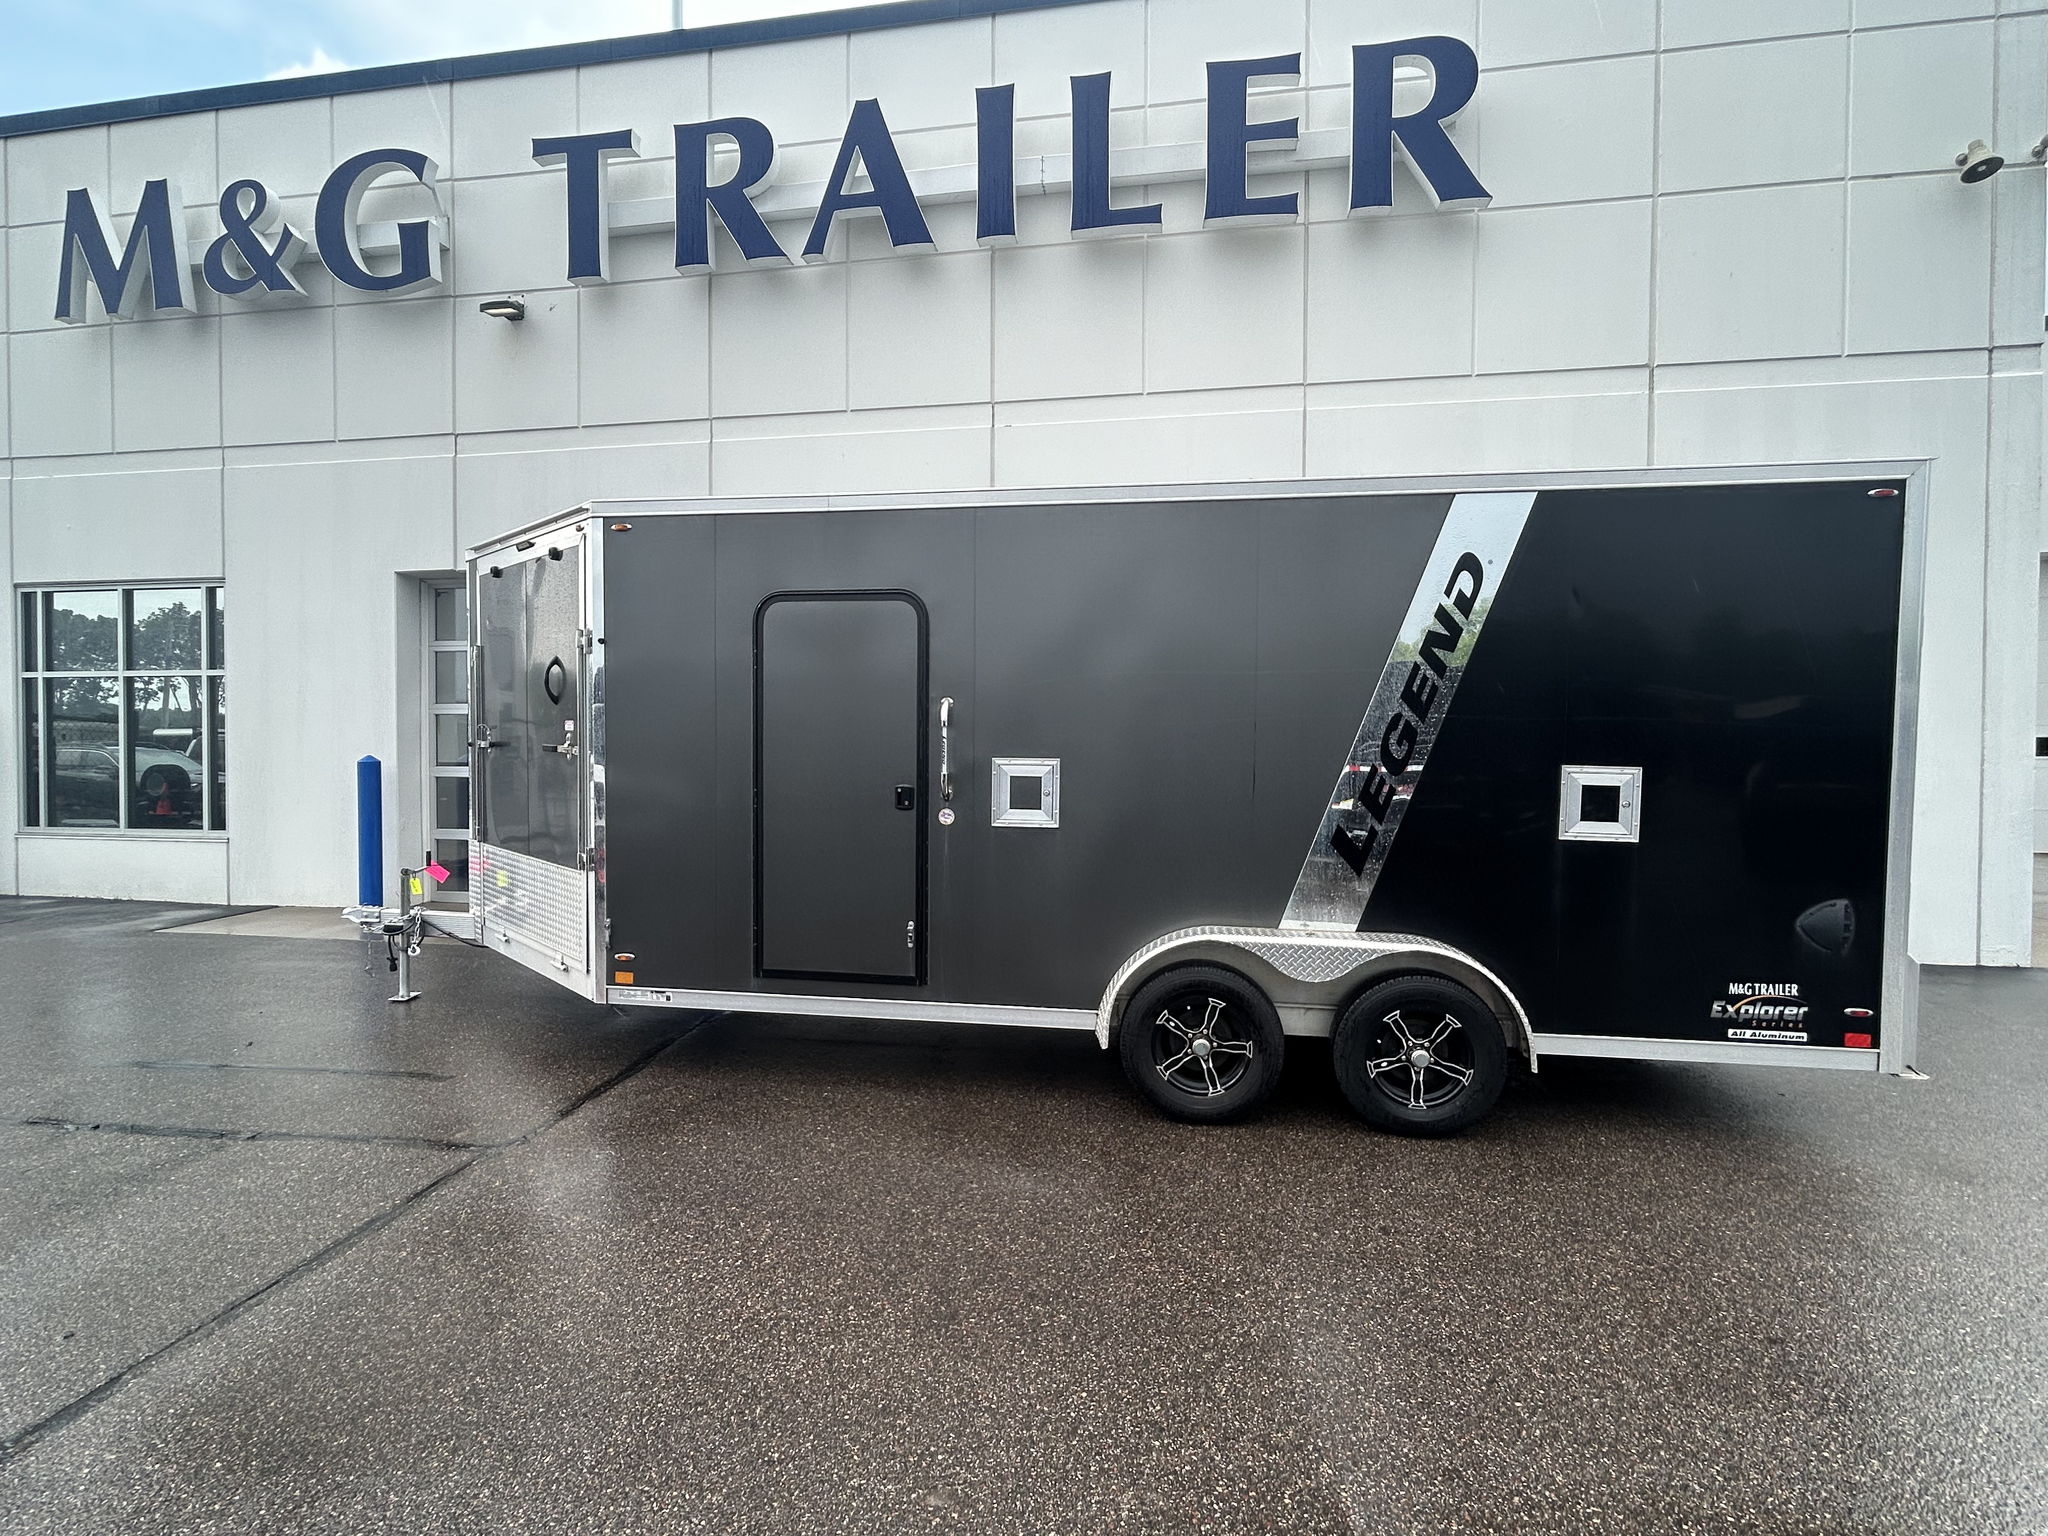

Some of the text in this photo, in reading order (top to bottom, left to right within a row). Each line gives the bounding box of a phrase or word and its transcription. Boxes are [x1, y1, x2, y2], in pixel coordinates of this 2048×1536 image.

[54, 35, 1492, 325] M&G TRAILER
[1330, 551, 1484, 877] LEGEND
[1728, 982, 1799, 996] M&G TRAILER
[1710, 1000, 1809, 1022] Explorer
[1751, 1019, 1803, 1028] Series
[1730, 1030, 1805, 1040] All Aluminum
